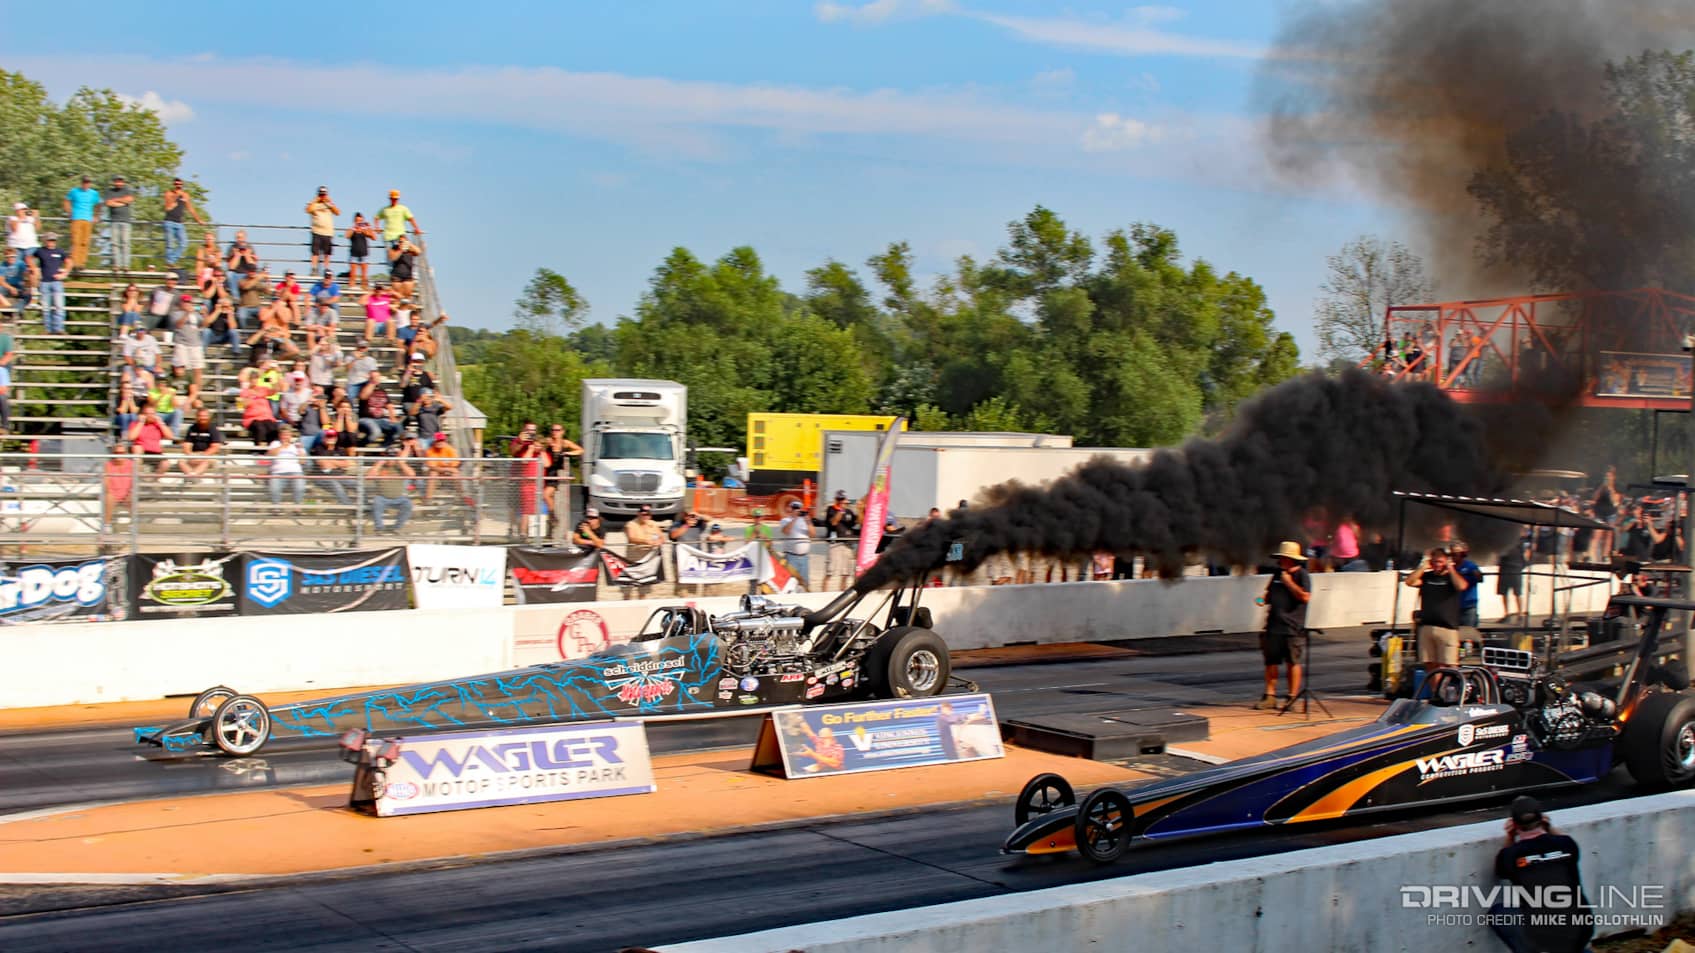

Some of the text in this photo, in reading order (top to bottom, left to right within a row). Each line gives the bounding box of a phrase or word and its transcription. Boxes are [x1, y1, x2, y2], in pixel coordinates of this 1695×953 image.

[821, 713, 843, 725] Go
[400, 735, 624, 780] WAGLER
[1415, 749, 1504, 774] WAGLER
[576, 767, 628, 784] PARK
[1421, 764, 1505, 781] COMPETITION PRODUCTS
